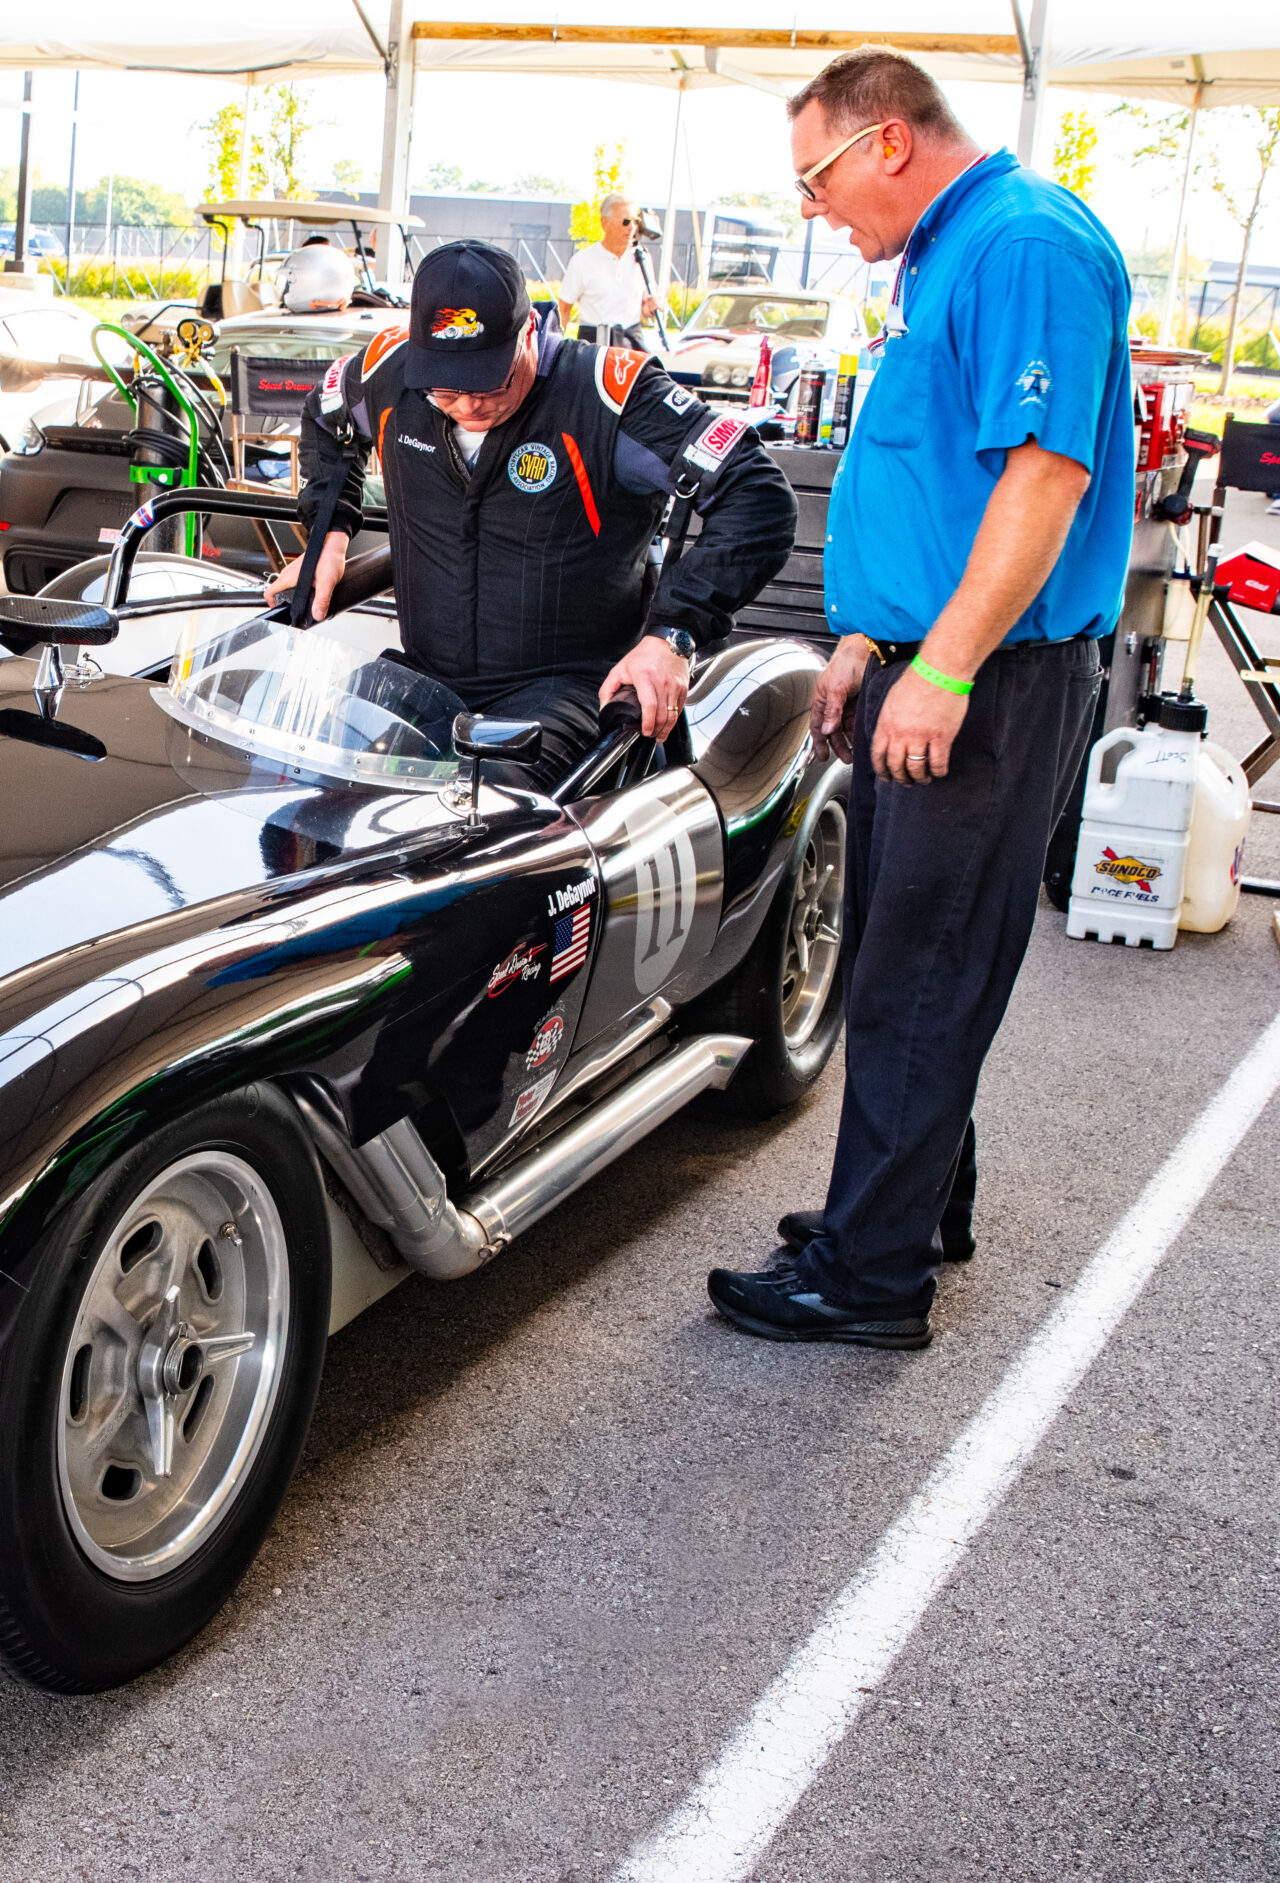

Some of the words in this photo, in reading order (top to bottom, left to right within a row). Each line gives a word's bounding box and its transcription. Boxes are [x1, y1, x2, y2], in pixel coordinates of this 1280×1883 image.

[708, 419, 744, 450] SIMP
[518, 453, 548, 481] SVRA
[1099, 862, 1160, 879] SUNOCO
[548, 894, 557, 917] J.
[556, 876, 596, 912] DeGaynor
